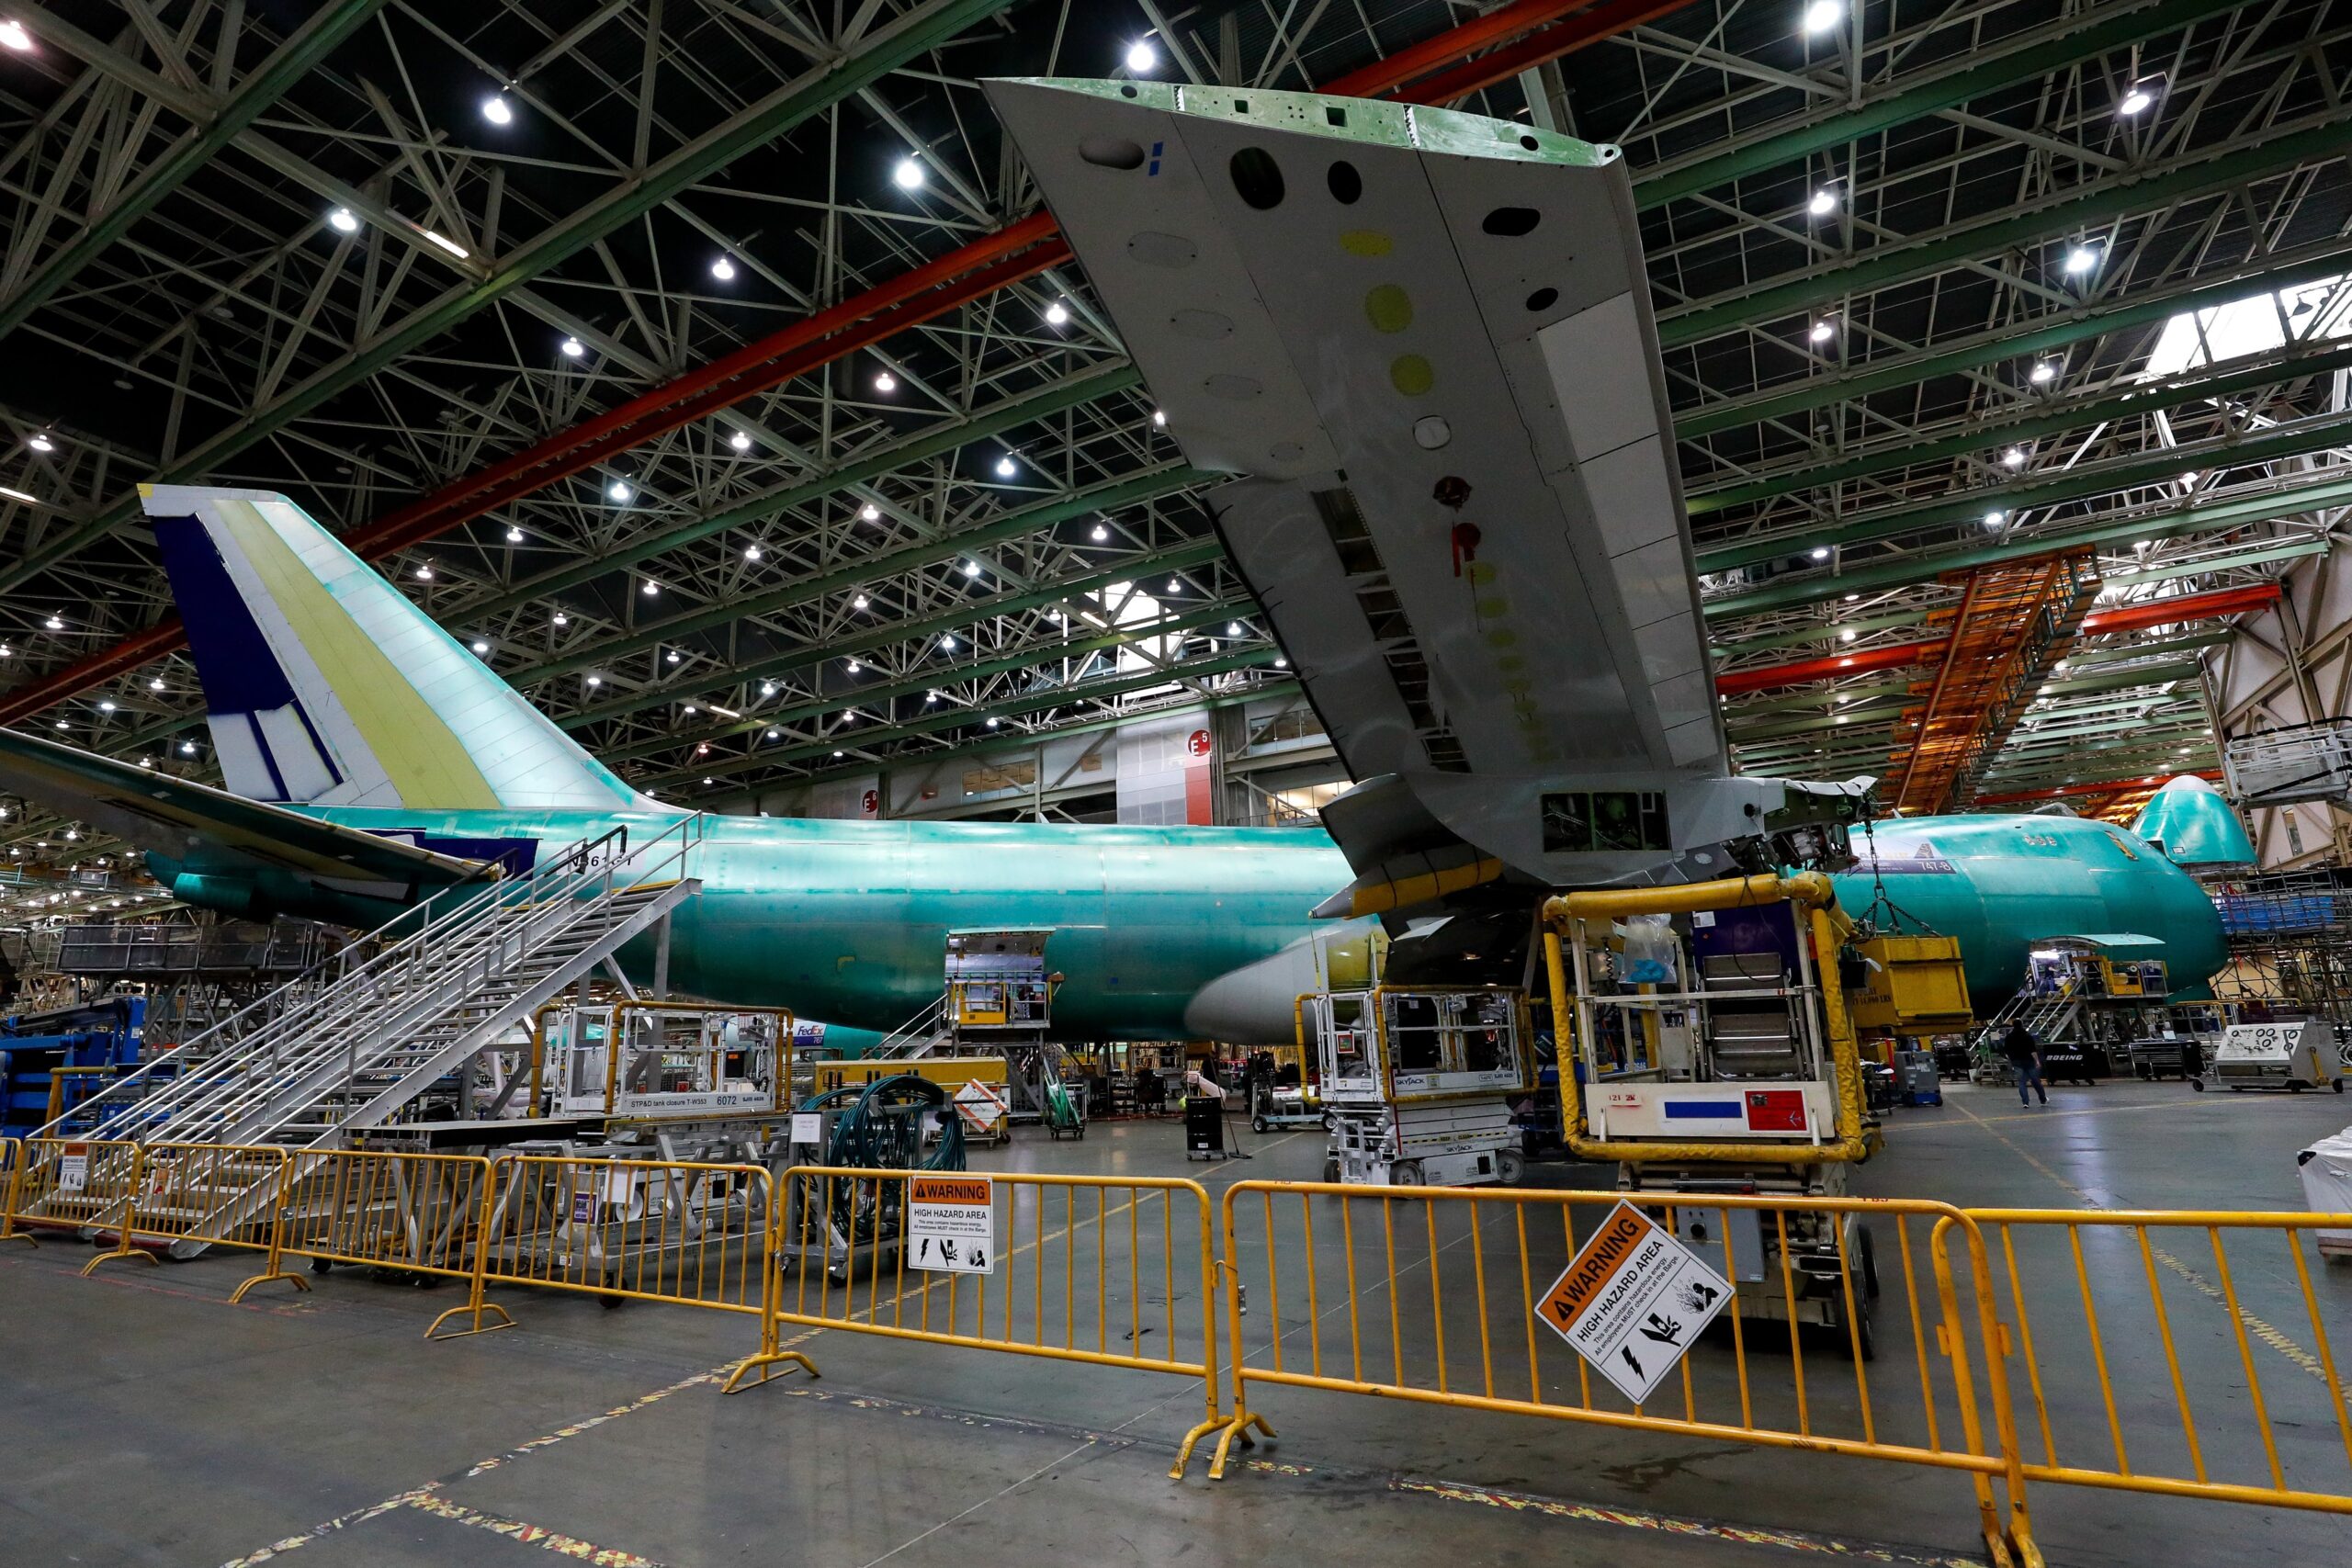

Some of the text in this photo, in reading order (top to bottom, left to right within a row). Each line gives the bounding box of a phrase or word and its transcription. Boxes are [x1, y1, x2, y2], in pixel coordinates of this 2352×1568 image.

[1917, 861, 1951, 871] 747-8
[797, 1025, 823, 1036] FedEx
[813, 1036, 823, 1044] 767
[1396, 1077, 1425, 1086] SKYJACK
[717, 1096, 737, 1106] 6072
[1446, 1144, 1474, 1153] SKYJACK
[927, 1184, 986, 1200] WARNING
[914, 1209, 987, 1220] HIGH HAZARD AREA
[1564, 1218, 1639, 1303] WARNING
[1576, 1240, 1664, 1343] HIGH HAZARD AREA
[1593, 1256, 1669, 1344] This area contains hazardous energy.
[1594, 1347, 1602, 1357] All
[1600, 1322, 1623, 1349] employees
[1621, 1307, 1636, 1325] MUST
[1634, 1291, 1649, 1309] check
[1656, 1269, 1666, 1281] the
[1663, 1254, 1680, 1274] Barge.
